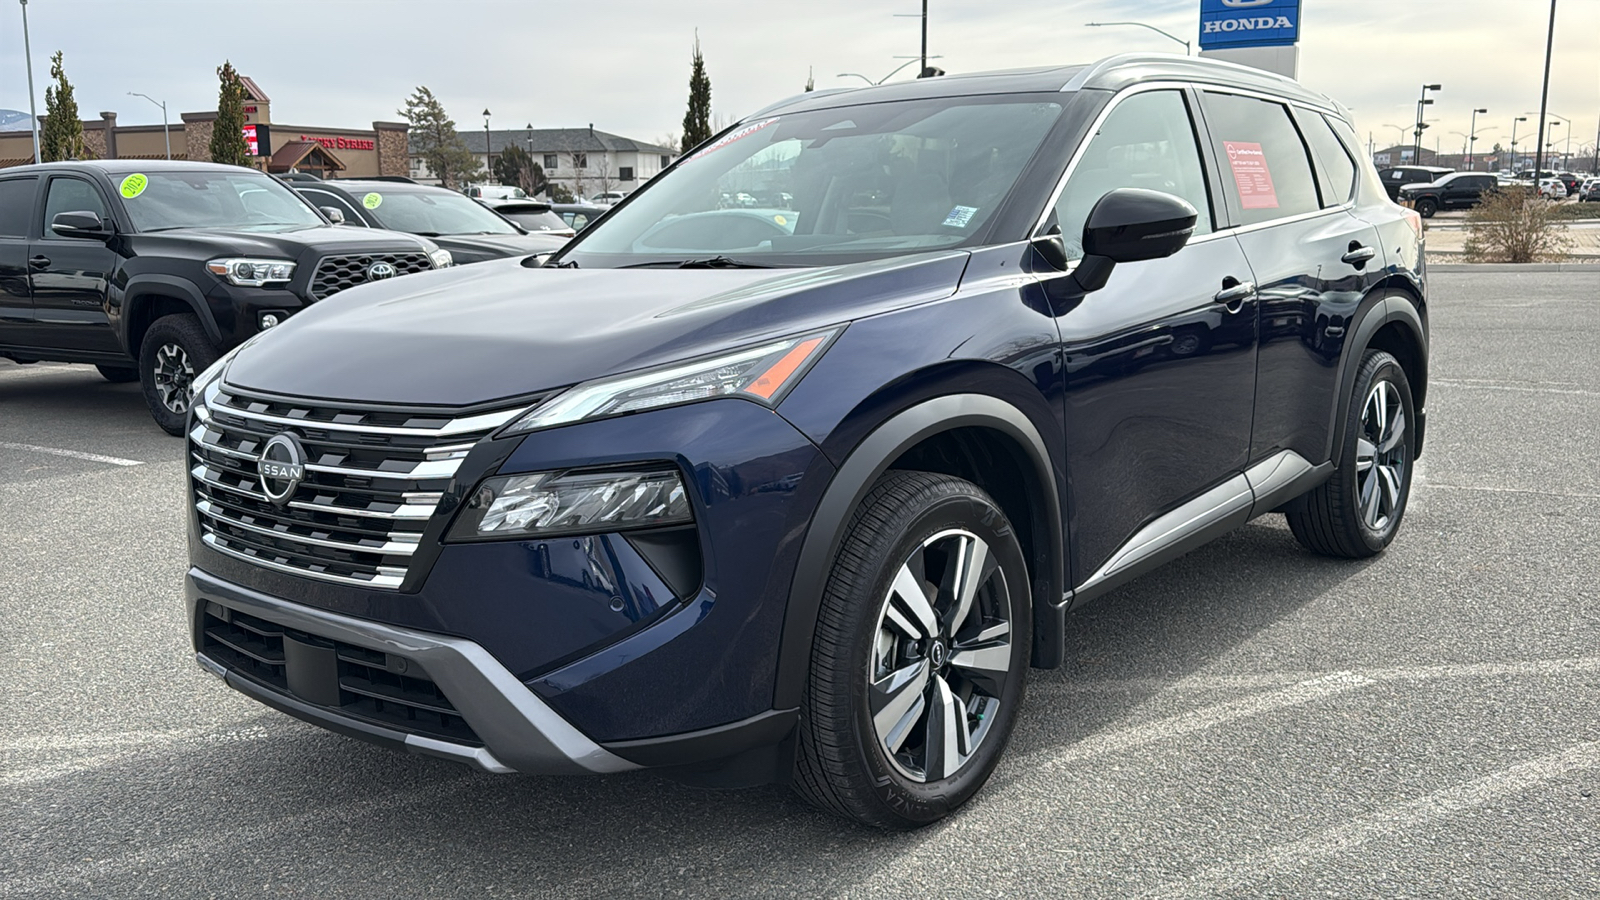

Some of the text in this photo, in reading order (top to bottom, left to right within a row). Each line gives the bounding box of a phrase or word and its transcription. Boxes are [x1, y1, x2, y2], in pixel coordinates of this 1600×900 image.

[1203, 16, 1293, 34] HONDA
[301, 135, 374, 150] CKY STRIKE
[124, 175, 143, 195] 2023
